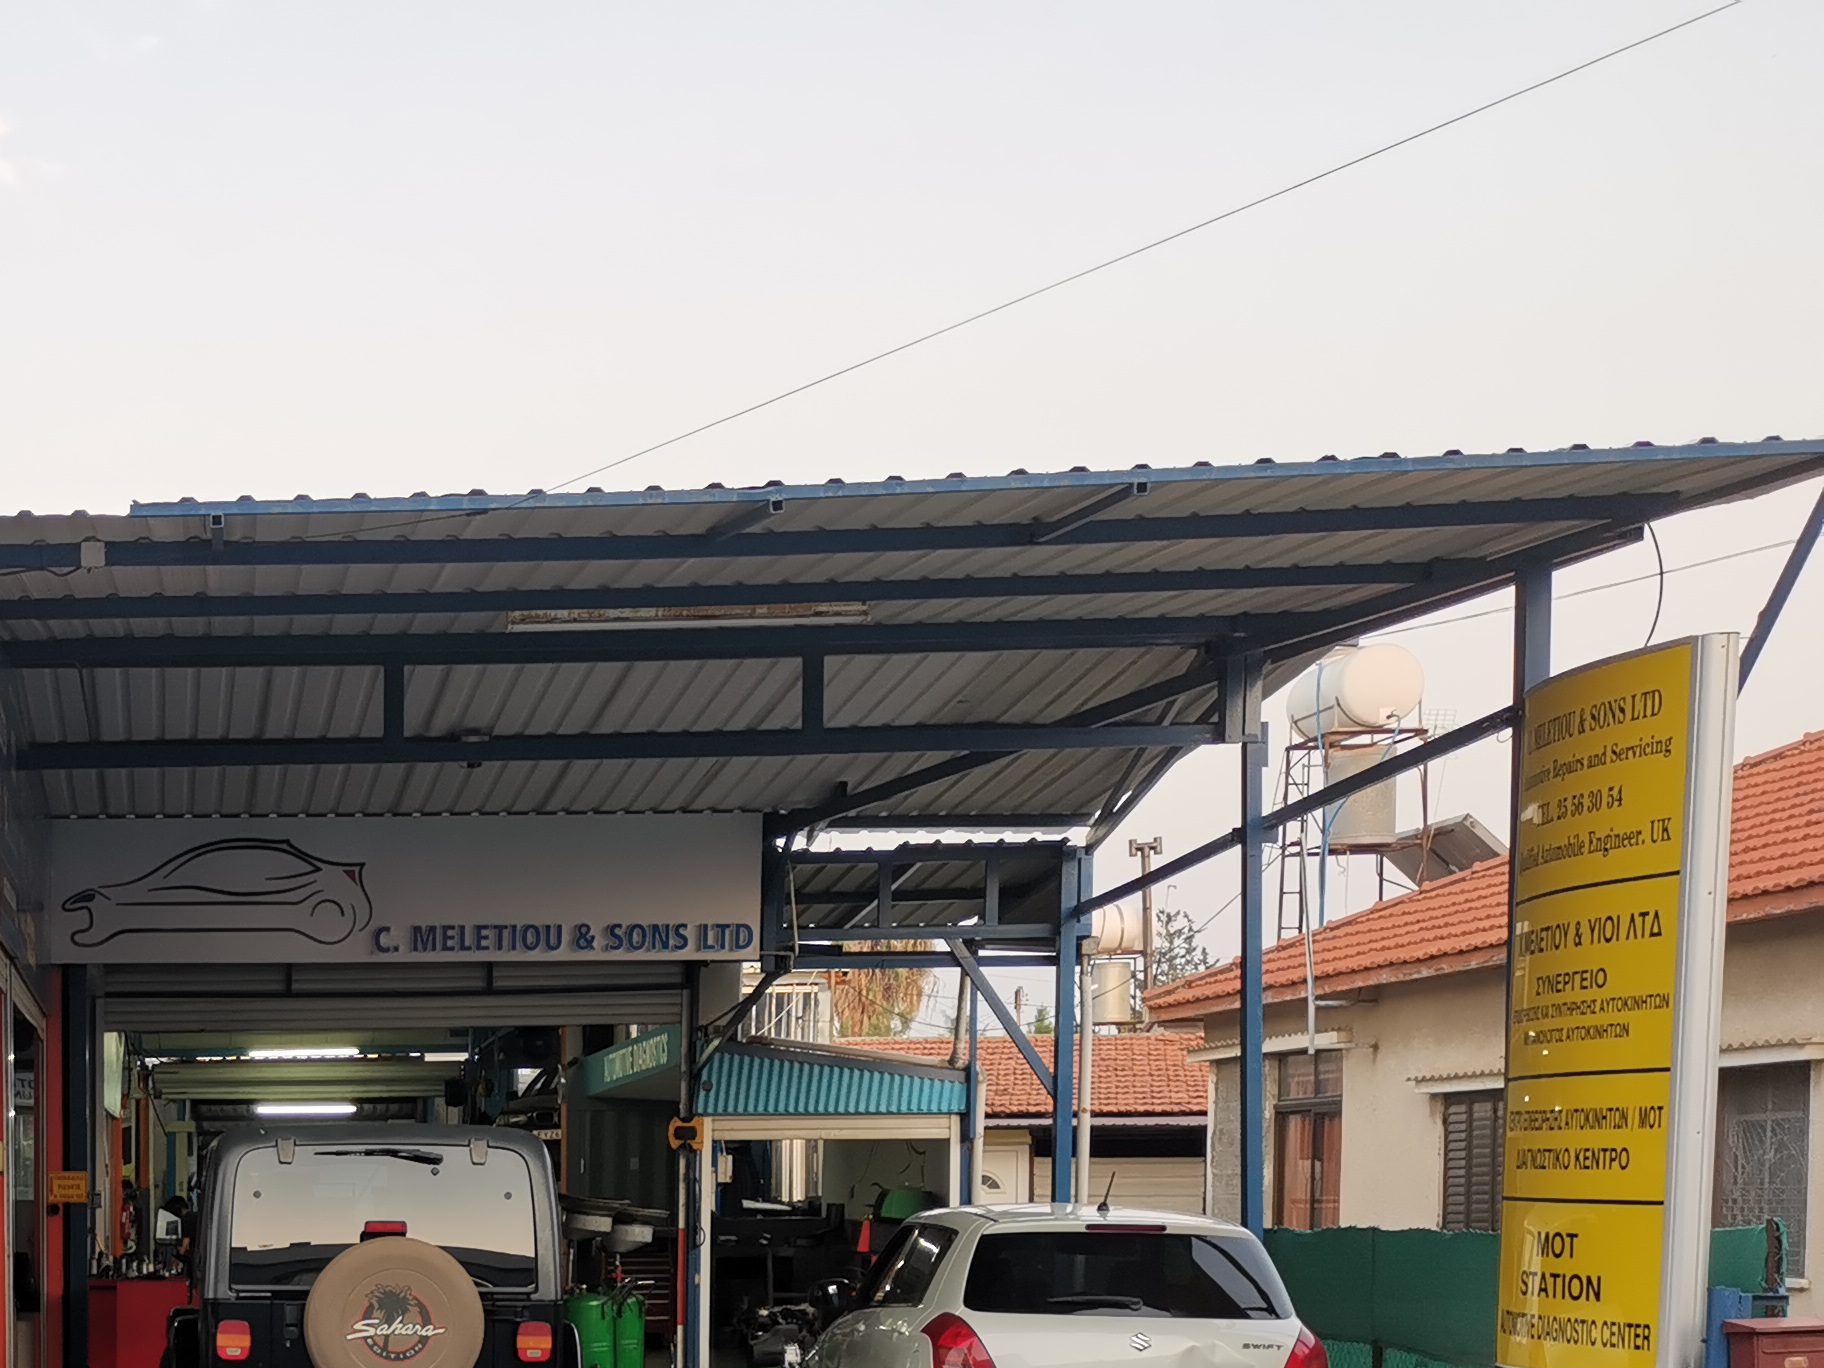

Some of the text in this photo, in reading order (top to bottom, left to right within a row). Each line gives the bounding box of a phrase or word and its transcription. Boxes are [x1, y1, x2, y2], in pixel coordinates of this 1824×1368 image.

[1589, 696, 1626, 733] SONS
[1629, 688, 1663, 722] LTD
[1552, 754, 1584, 782] Repairs
[1587, 745, 1607, 770] and
[1609, 735, 1673, 764] Servicing
[1556, 796, 1568, 821] 25
[1570, 792, 1584, 818] 56
[1587, 789, 1603, 814] 30
[1606, 784, 1623, 810] 54
[1650, 817, 1673, 844] UK
[375, 922, 754, 953] C. MELETIOU & SONS LTD
[1573, 921, 1583, 948] &
[1588, 914, 1621, 945] ΥΙΟΙ
[1626, 909, 1662, 941] ΛΤΔ
[1535, 967, 1608, 997] ΣΥΝΕΡΓΕΙΟ
[1600, 992, 1670, 1014] ΑΥΤΟΚΙΝΗΤΩΝ
[1565, 1022, 1630, 1043] ΑΥΤΟΚΙΝΗΤΩΝ
[1564, 1106, 1628, 1131] ΑΥΤΟΚΙΝΗΤΩΝ
[1573, 1147, 1630, 1171] ΚΕΝΤΡΟ
[1536, 1231, 1579, 1259] MOT
[1520, 1269, 1602, 1302] STATION
[346, 1315, 446, 1340] Sahara
[1537, 1315, 1597, 1347] DIAGNOSTIC
[1601, 1320, 1652, 1351] CENTER
[1242, 1342, 1283, 1350] SWIFT
